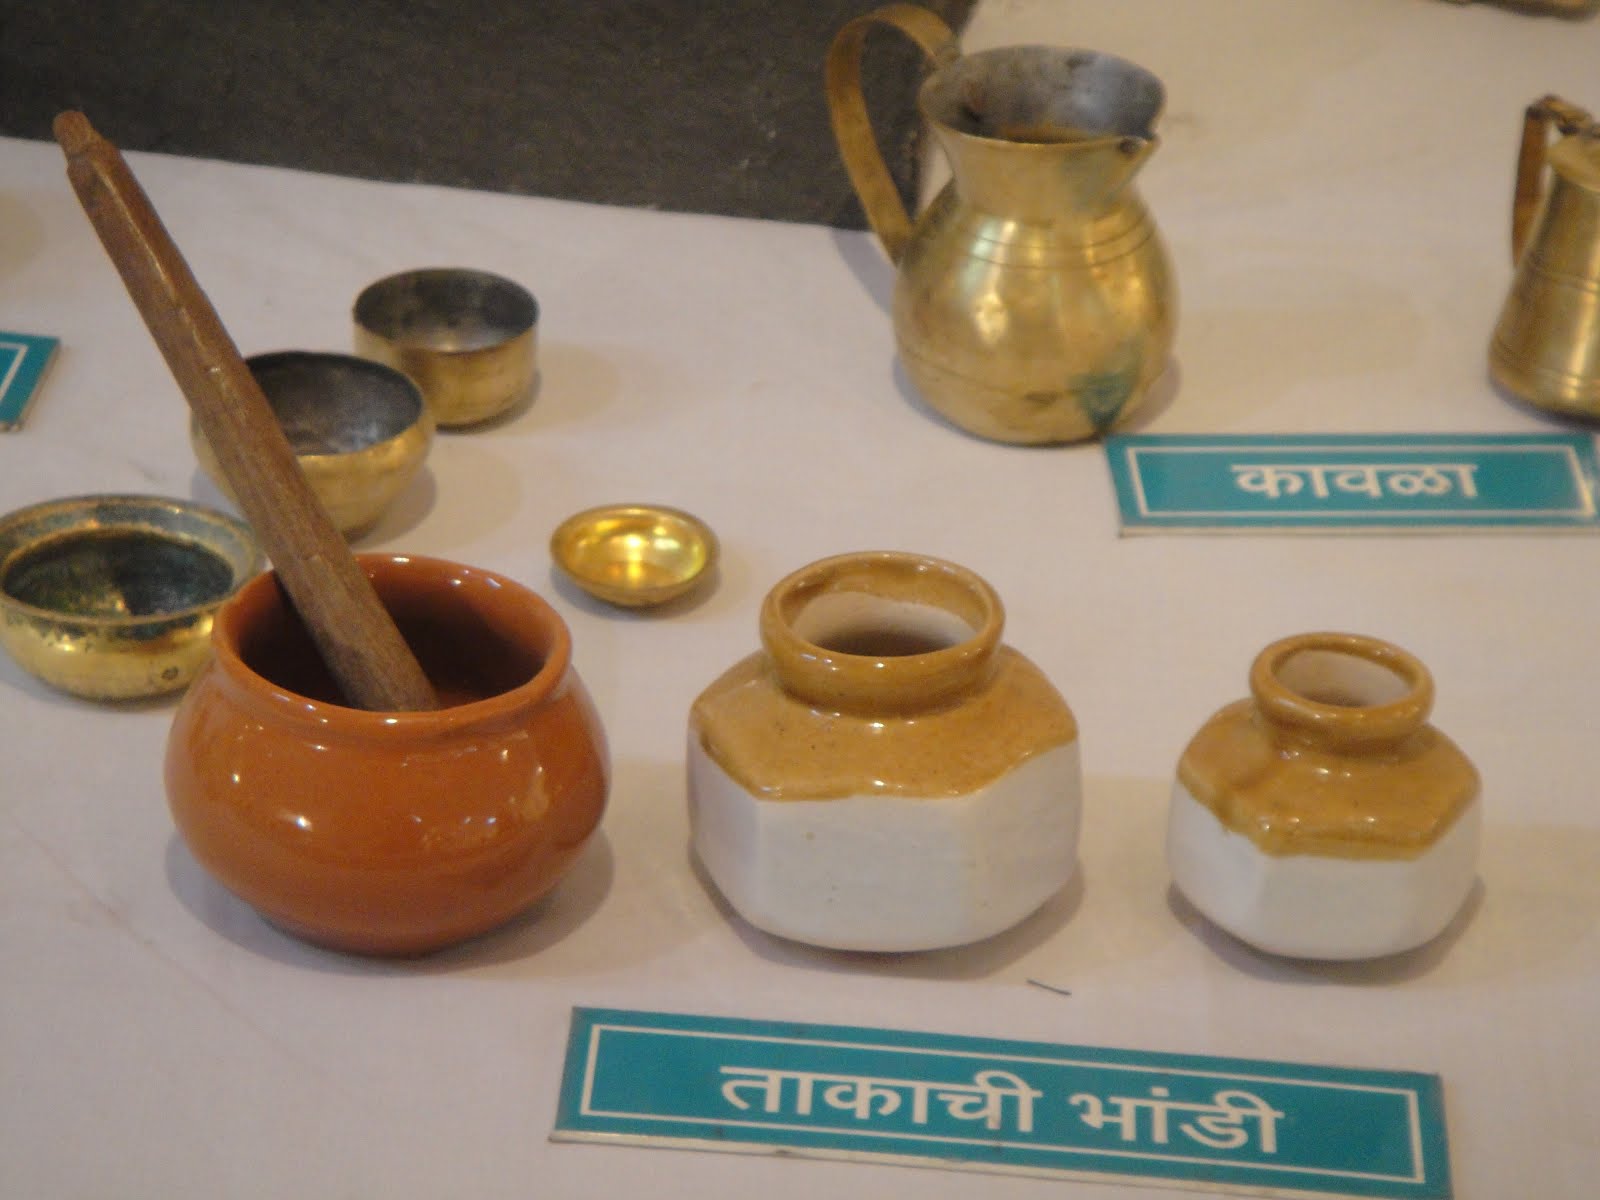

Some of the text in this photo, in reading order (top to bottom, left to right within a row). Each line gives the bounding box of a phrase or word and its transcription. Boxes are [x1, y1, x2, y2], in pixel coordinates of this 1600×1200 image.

[1231, 463, 1479, 498] कावळा
[720, 1066, 1284, 1155] ताकाची भांडी
